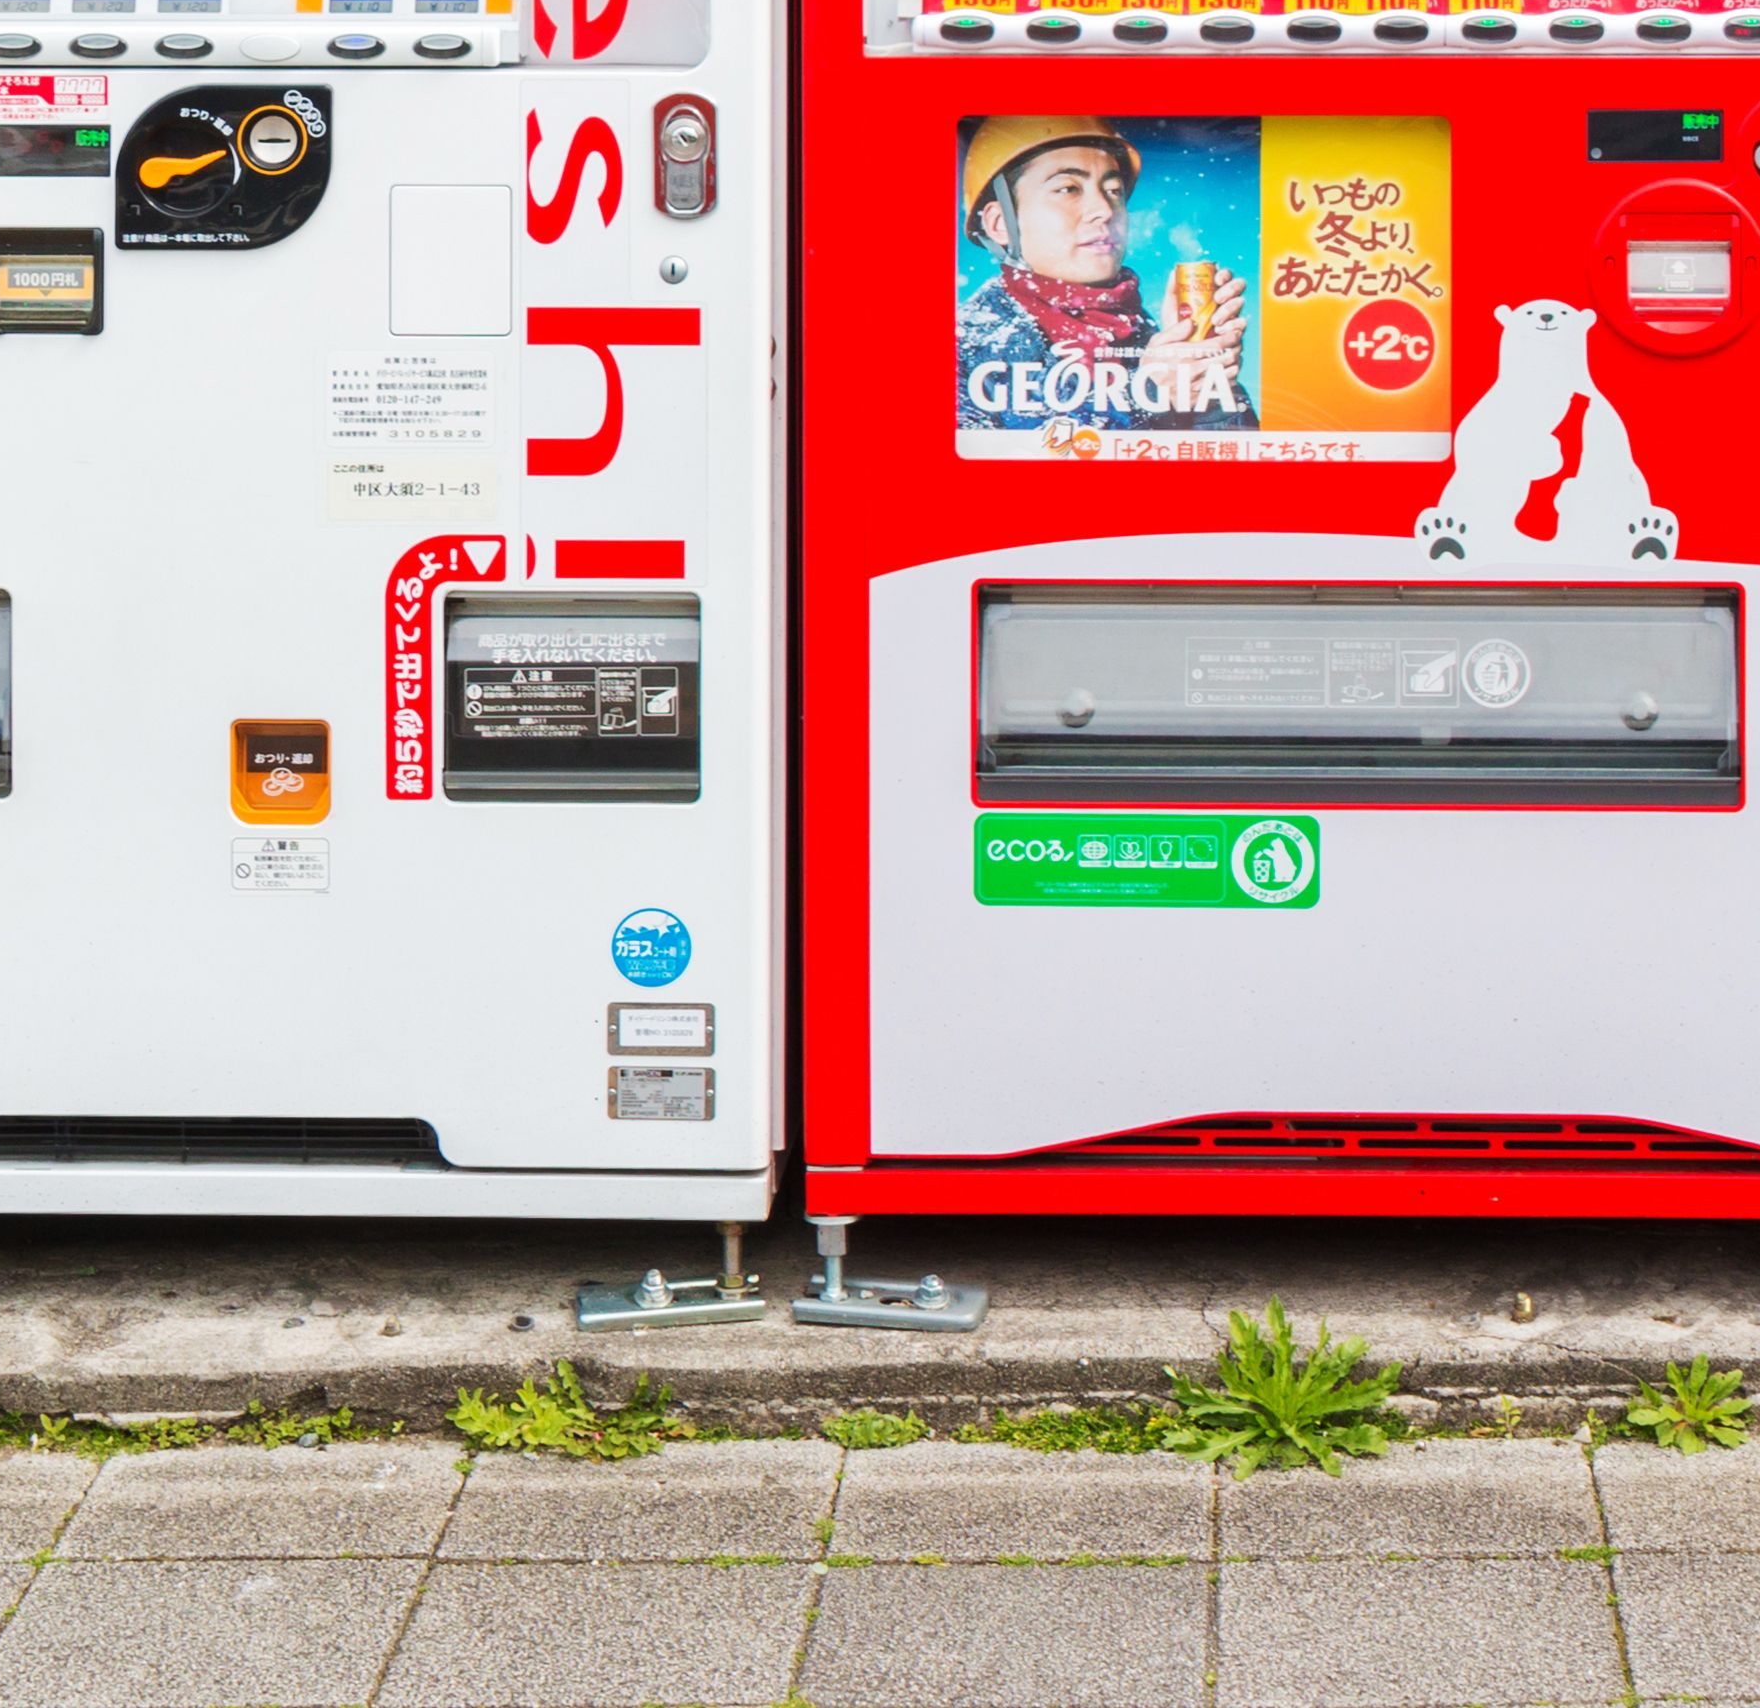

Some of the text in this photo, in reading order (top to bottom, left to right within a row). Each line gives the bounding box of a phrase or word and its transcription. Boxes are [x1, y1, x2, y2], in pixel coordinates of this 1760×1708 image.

[1289, 177, 1400, 212] いつもの
[1316, 212, 1416, 257] 冬より、
[13, 271, 79, 288] 1000円札
[1273, 257, 1444, 298] あたたかく。
